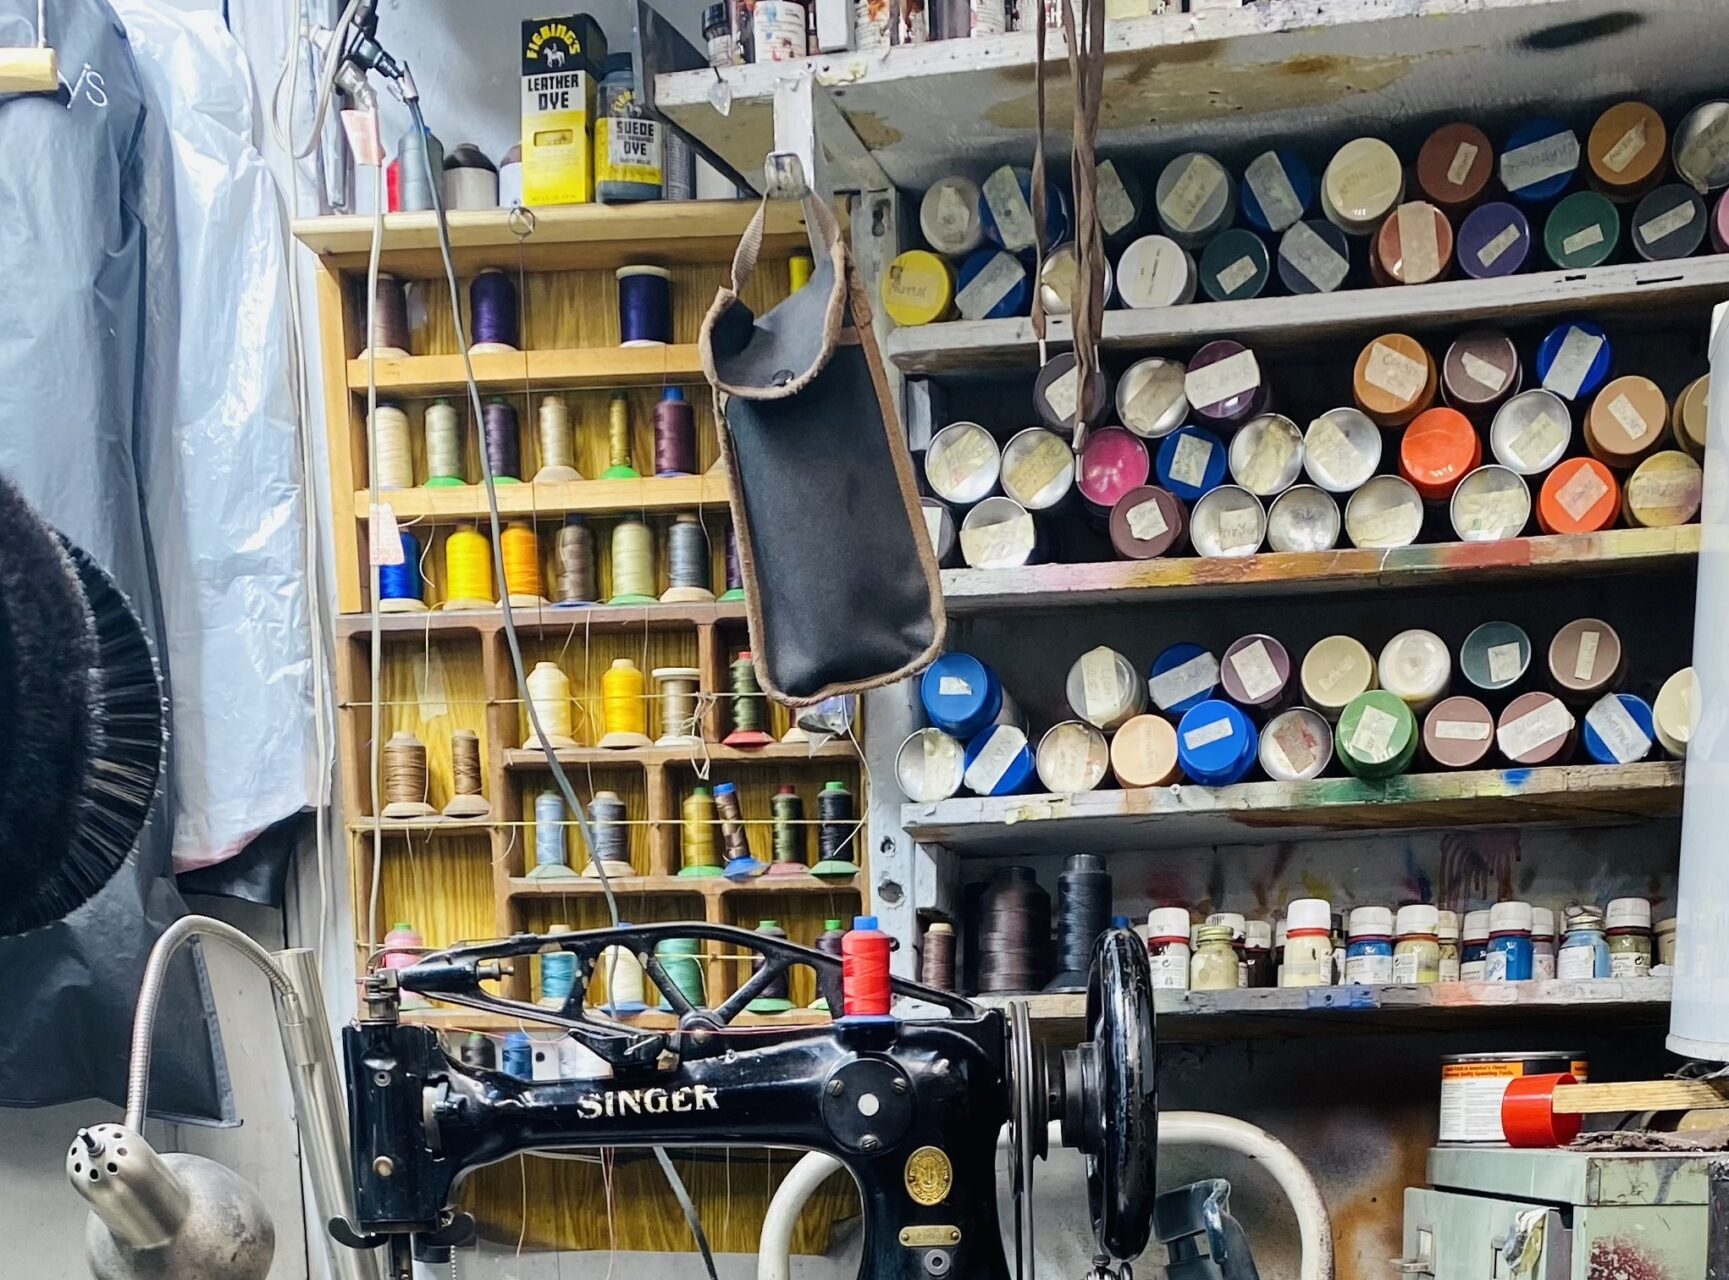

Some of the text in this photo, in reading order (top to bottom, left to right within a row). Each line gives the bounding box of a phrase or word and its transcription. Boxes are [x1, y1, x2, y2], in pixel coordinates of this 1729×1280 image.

[527, 73, 579, 92] LEATHER
[538, 92, 569, 111] DYE
[616, 120, 654, 137] SUEDE
[623, 142, 647, 156] DYE
[576, 1084, 720, 1120] SINGER
